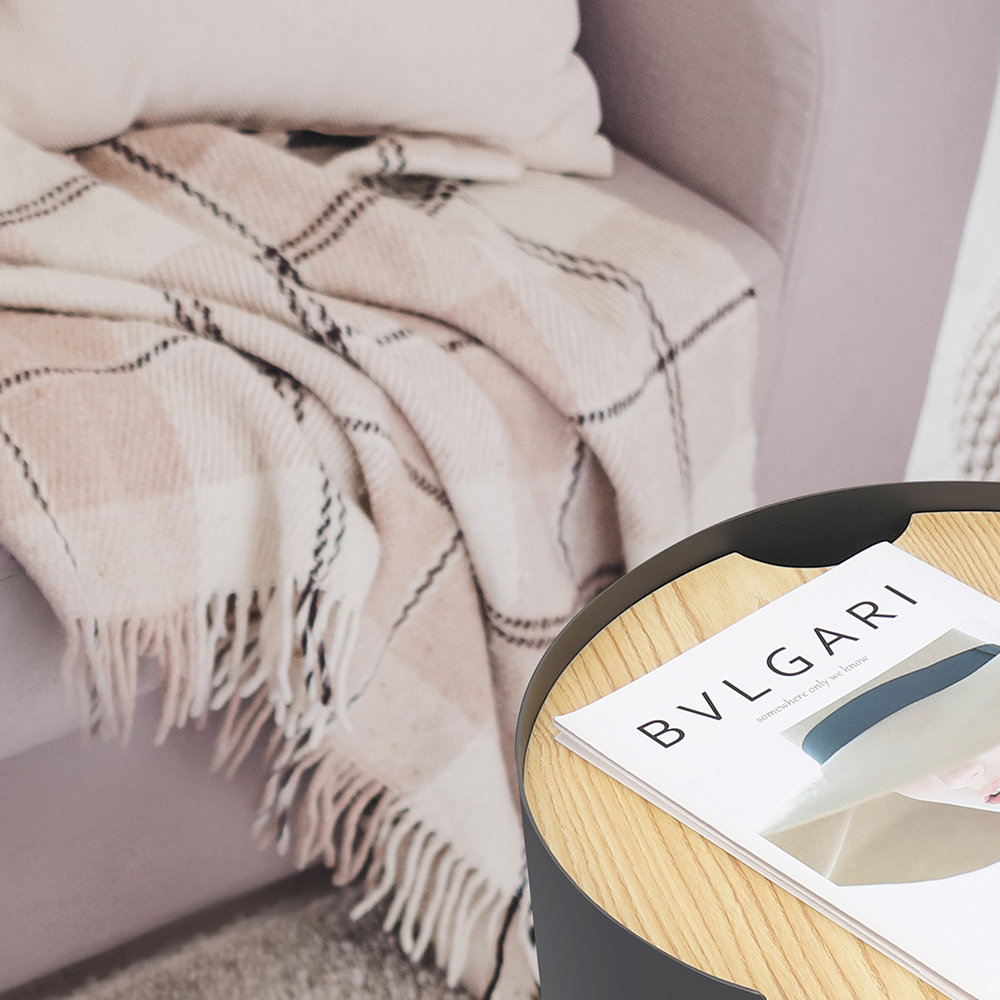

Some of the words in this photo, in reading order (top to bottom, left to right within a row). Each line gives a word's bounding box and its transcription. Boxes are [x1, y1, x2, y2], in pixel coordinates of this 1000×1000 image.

[636, 584, 918, 748] BVLGARI
[756, 691, 809, 723] somewhere
[808, 679, 831, 694] only
[829, 669, 843, 682] we
[839, 655, 869, 674] know
